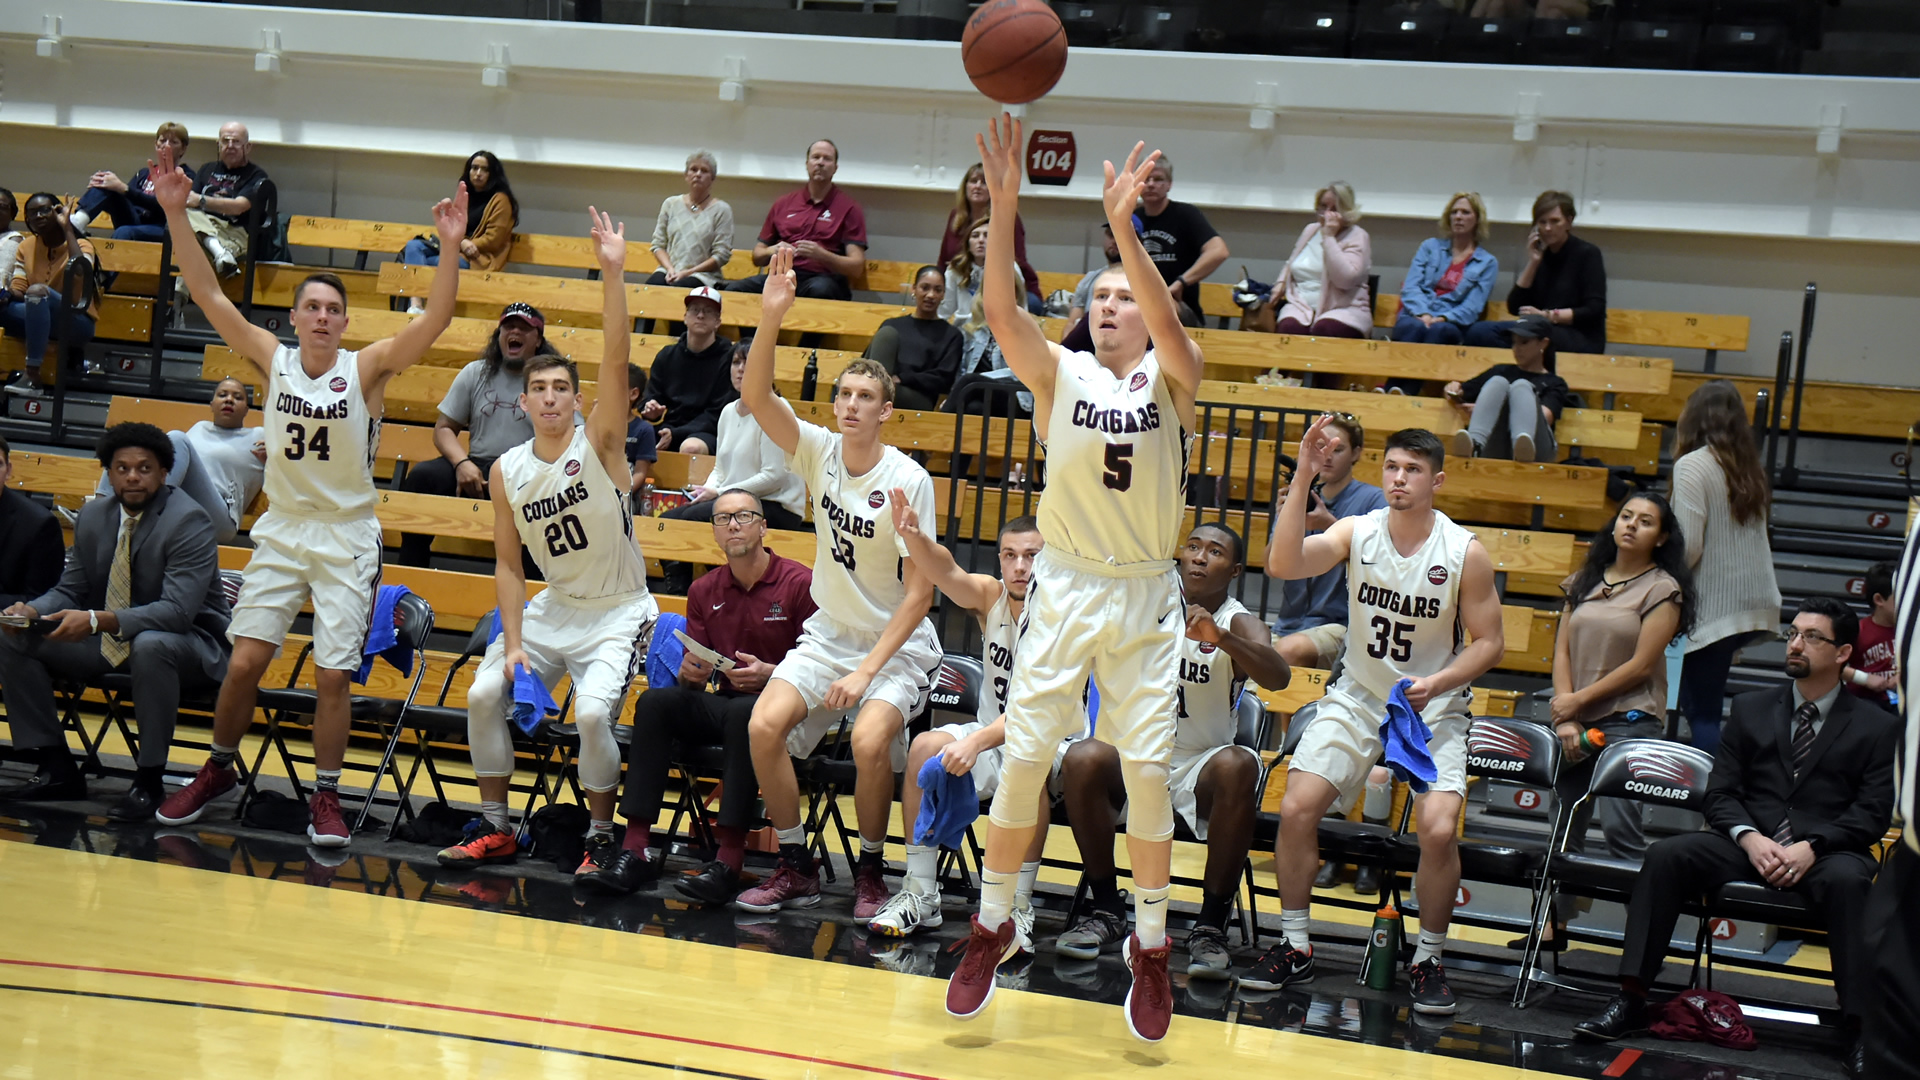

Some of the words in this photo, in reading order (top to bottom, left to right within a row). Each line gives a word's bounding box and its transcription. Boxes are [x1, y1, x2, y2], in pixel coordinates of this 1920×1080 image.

[1037, 135, 1069, 144] Section
[1031, 149, 1072, 171] 104
[373, 223, 384, 232] 52
[104, 242, 115, 250] 20
[485, 273, 492, 282] 2
[701, 286, 710, 296] A
[268, 319, 278, 329] G
[1685, 317, 1697, 327] 70
[1280, 336, 1291, 345] 12
[801, 351, 807, 359] 7
[1456, 349, 1466, 358] 14
[122, 359, 132, 371] F
[1227, 385, 1238, 394] 12
[28, 402, 38, 413] E
[276, 392, 348, 420] COUGARS
[810, 406, 817, 416] 8
[898, 414, 905, 423] 9
[1072, 399, 1161, 435] COUGARS
[1602, 414, 1614, 423] 16
[284, 422, 331, 461] 34
[1365, 452, 1377, 461] 14
[1103, 442, 1134, 493] 5
[1566, 470, 1579, 480] 16
[382, 494, 389, 503] 5
[522, 480, 589, 523] COUARS
[472, 503, 479, 512] 6
[1871, 514, 1885, 527] F
[658, 522, 665, 532] 8
[544, 513, 589, 557] 20
[1517, 535, 1531, 545] 16
[1851, 580, 1865, 594] E
[1357, 581, 1441, 619] COUGARS
[1366, 615, 1416, 663] 35
[1307, 673, 1321, 684] 15
[1624, 780, 1690, 801] COUGARS
[1518, 791, 1535, 806] B
[1712, 919, 1730, 938] A
[1373, 928, 1387, 948] G
